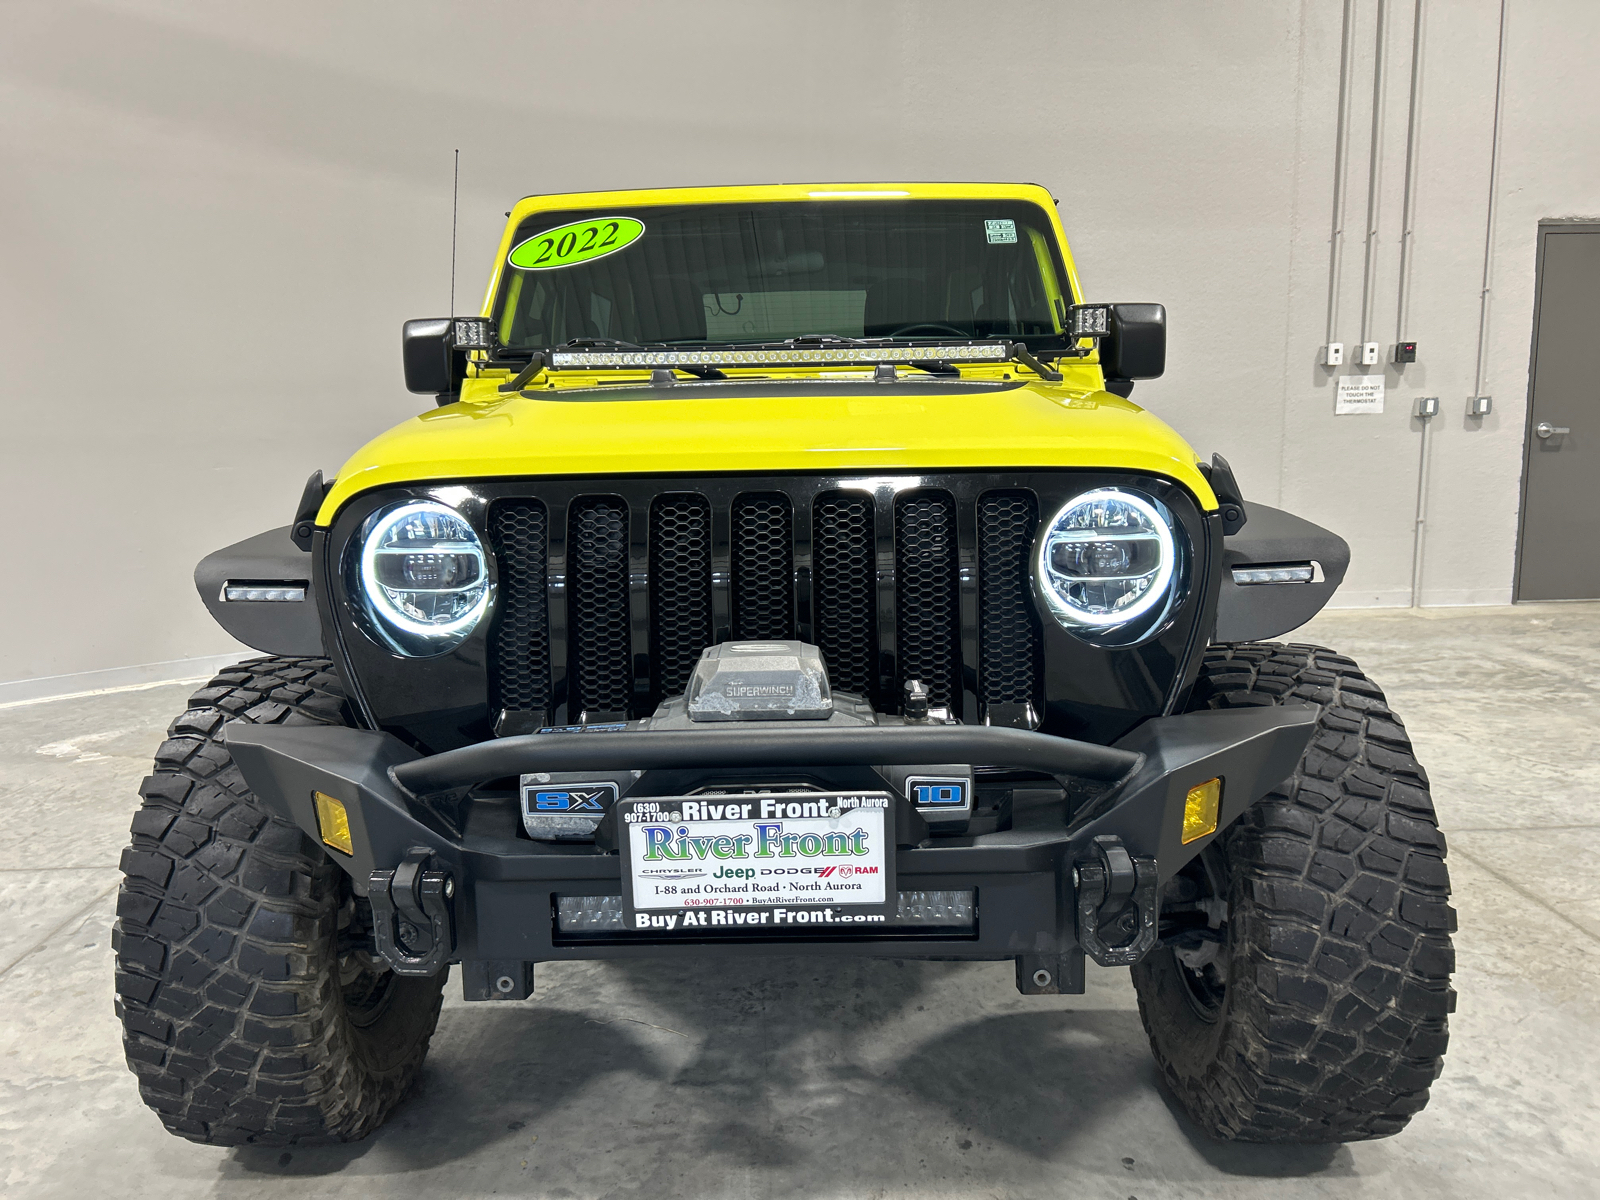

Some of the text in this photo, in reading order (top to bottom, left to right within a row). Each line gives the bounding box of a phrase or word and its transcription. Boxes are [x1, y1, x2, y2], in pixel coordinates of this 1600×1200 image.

[533, 222, 619, 264] 2022
[726, 685, 794, 697] SUPERWINCH
[536, 790, 604, 811] SX
[914, 786, 961, 803] 10
[633, 803, 660, 813] (630)
[682, 798, 829, 820] River Front
[837, 797, 889, 808] North Aurora
[624, 812, 669, 822] 907-1700
[641, 822, 869, 861] River Front
[713, 866, 756, 880] Jeep
[760, 867, 825, 875] DODGE
[654, 882, 862, 894] I-88 and Orchard Road North Aurora
[684, 896, 834, 906] 630-907-1700 BuyAtRiverFront.com
[635, 908, 886, 930] Buy At River Front.com
